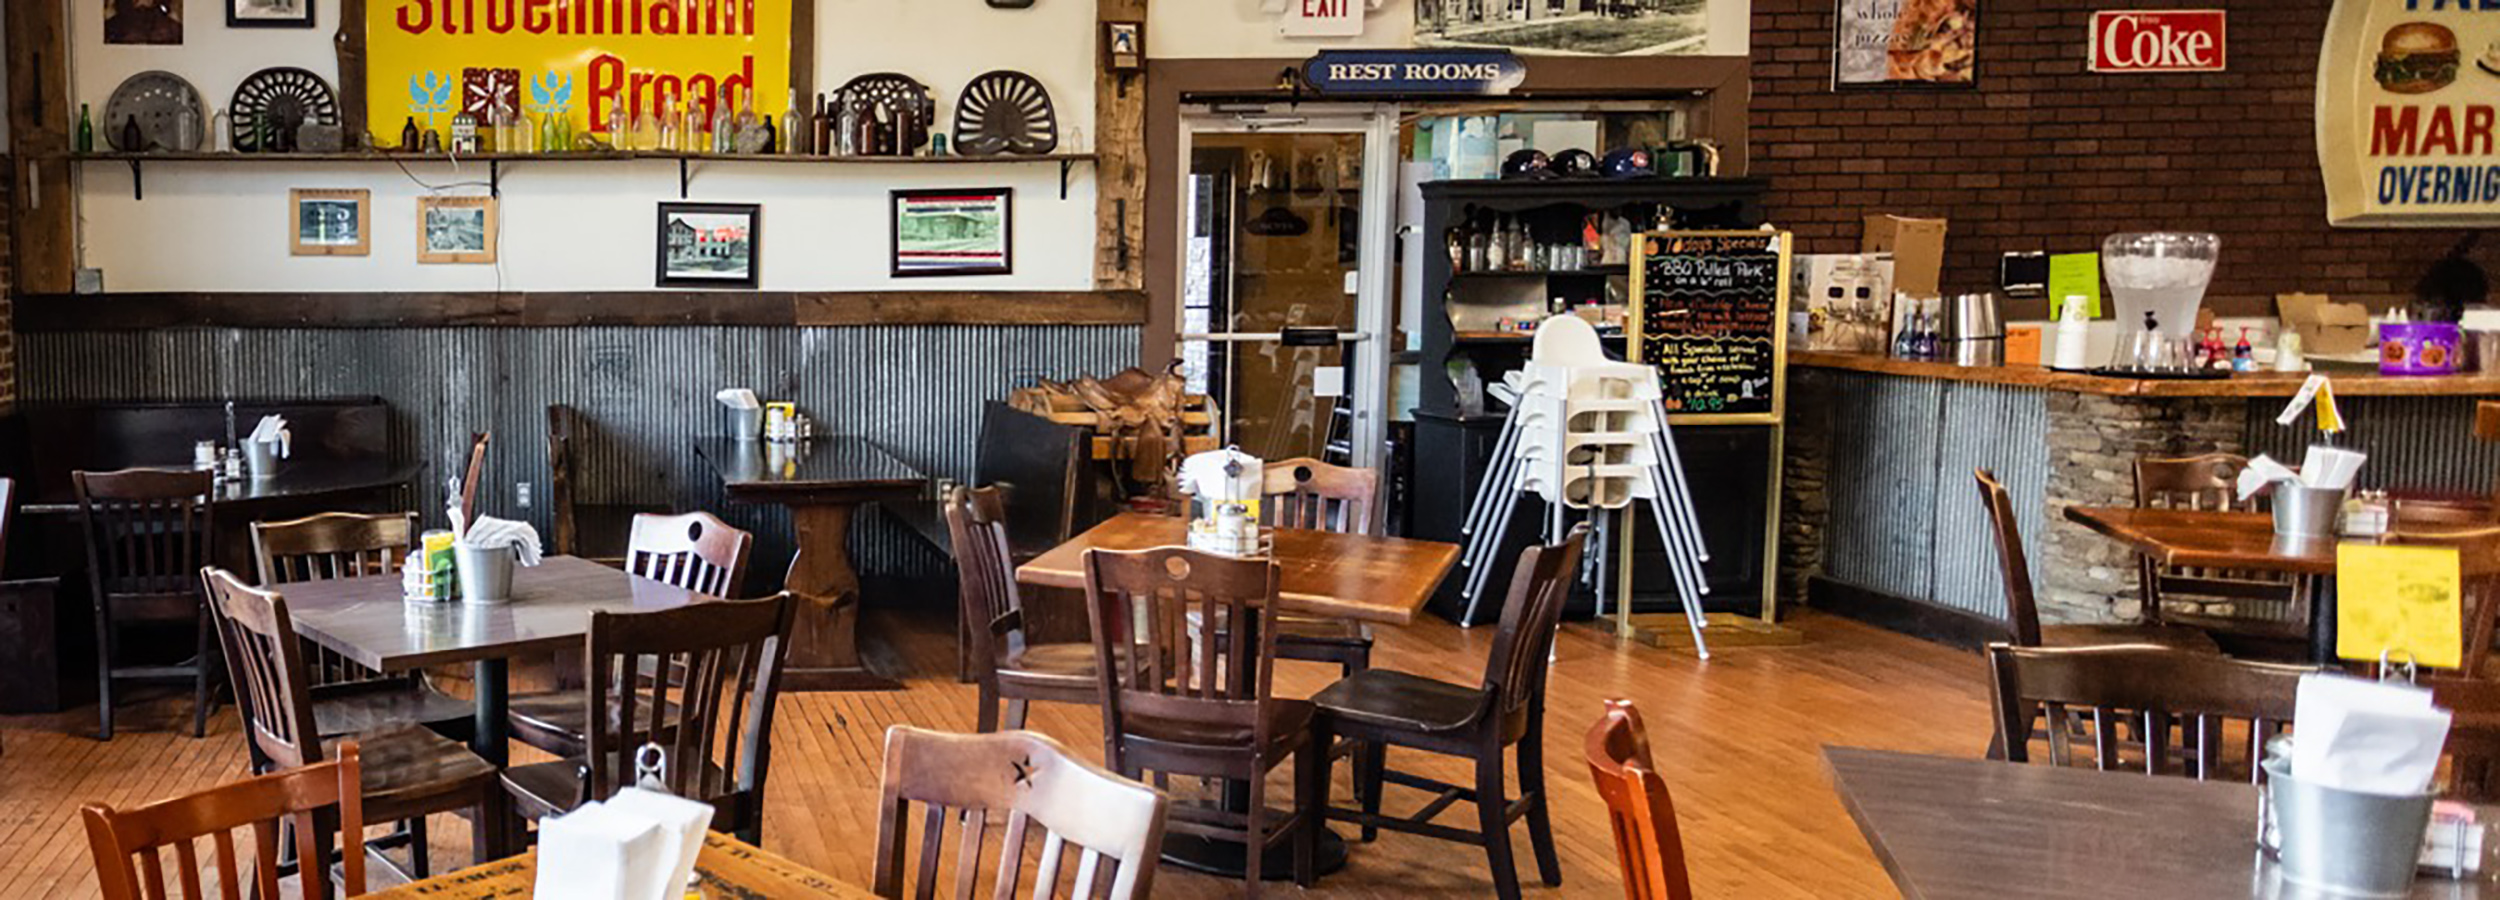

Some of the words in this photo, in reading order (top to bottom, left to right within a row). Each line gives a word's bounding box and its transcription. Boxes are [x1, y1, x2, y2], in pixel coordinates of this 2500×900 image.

[2104, 15, 2213, 67] Coke
[1329, 63, 1396, 80] REST
[1403, 63, 1500, 80] ROOMS
[588, 54, 754, 133] Bread
[2370, 105, 2495, 156] MAR
[1659, 259, 1692, 276] BBQ
[1694, 259, 1730, 276] Pulled
[1734, 261, 1764, 276] Pork
[1713, 277, 1733, 286] roll
[1662, 343, 1679, 355] All
[1682, 341, 1723, 356] Specials
[1729, 354, 1741, 364] of
[1705, 375, 1716, 384] of
